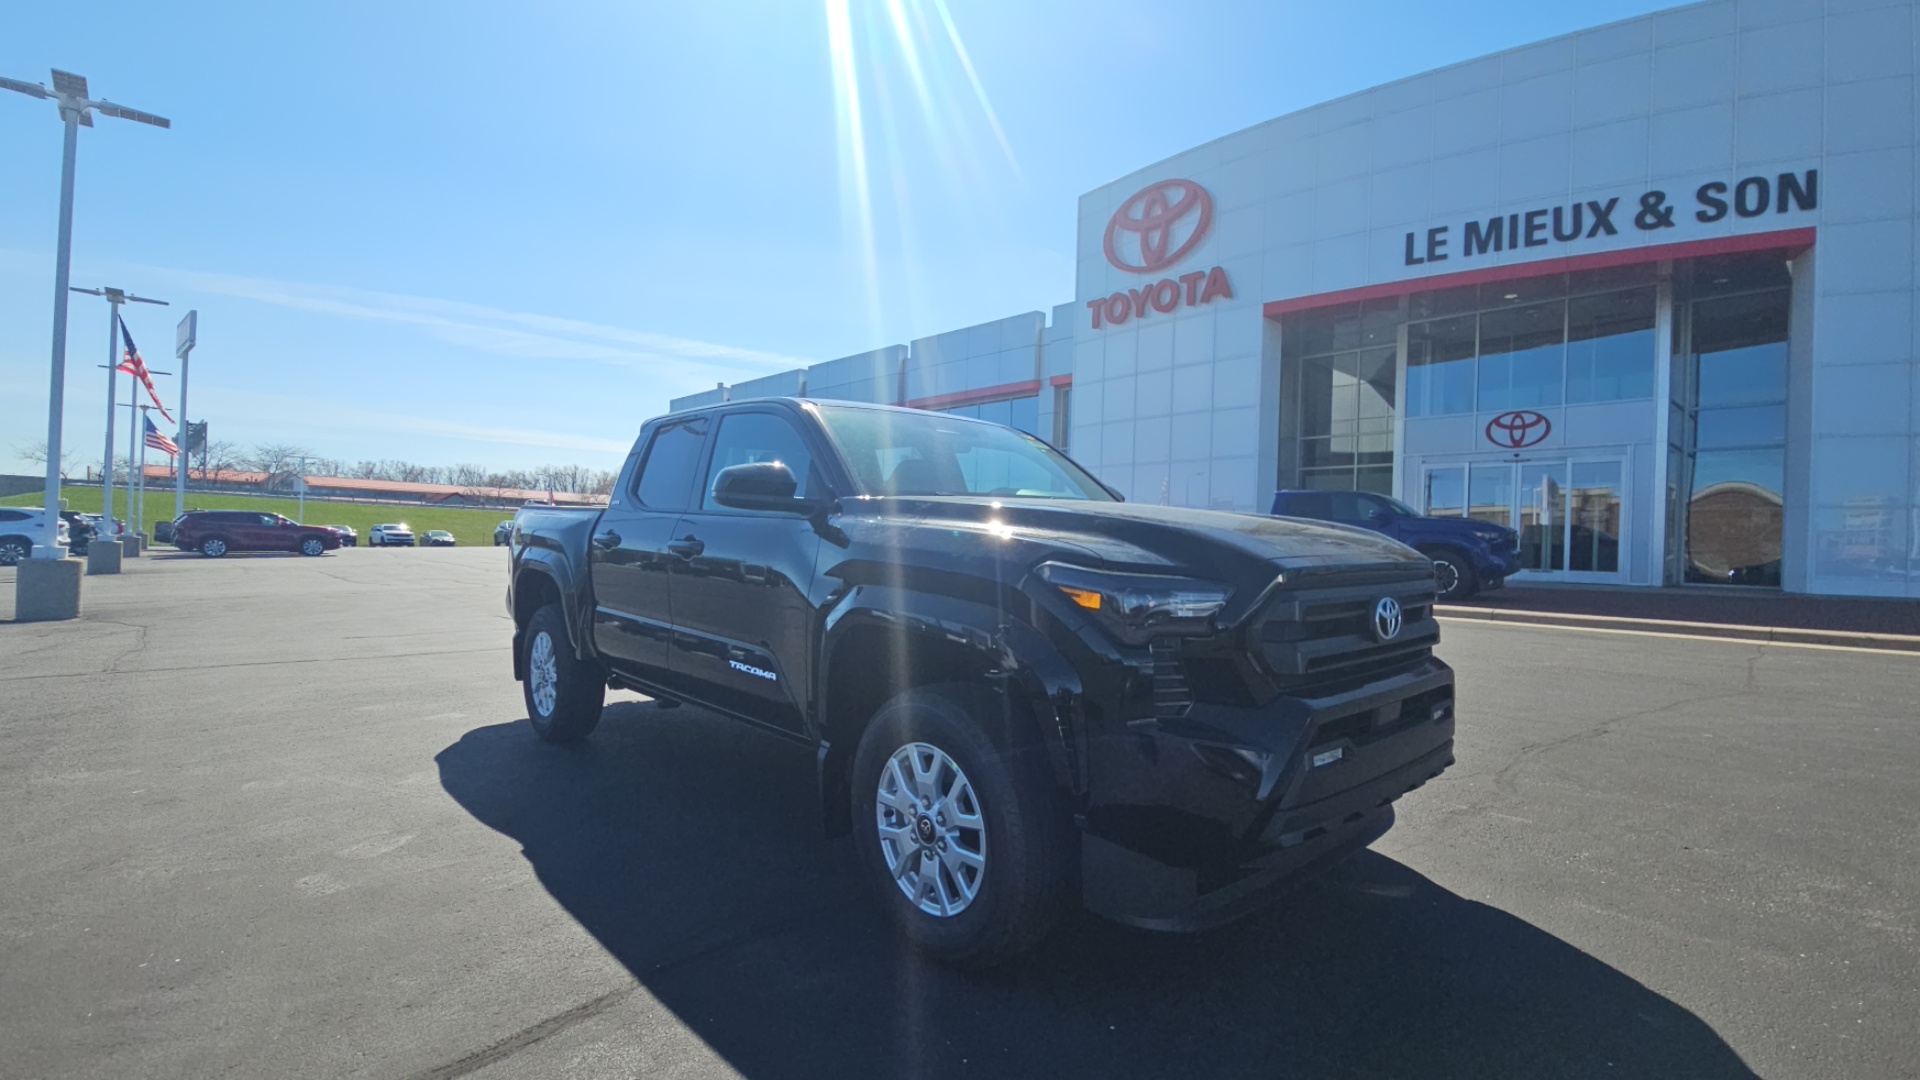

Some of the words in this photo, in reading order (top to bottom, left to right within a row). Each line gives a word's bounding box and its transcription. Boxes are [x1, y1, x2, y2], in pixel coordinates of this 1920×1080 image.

[1405, 226, 1448, 266] LE
[1464, 197, 1619, 257] MIEUX
[1634, 190, 1675, 231] &
[1695, 169, 1818, 223] SON
[1087, 266, 1233, 330] TOYOTA
[729, 660, 777, 681] TACOMA
